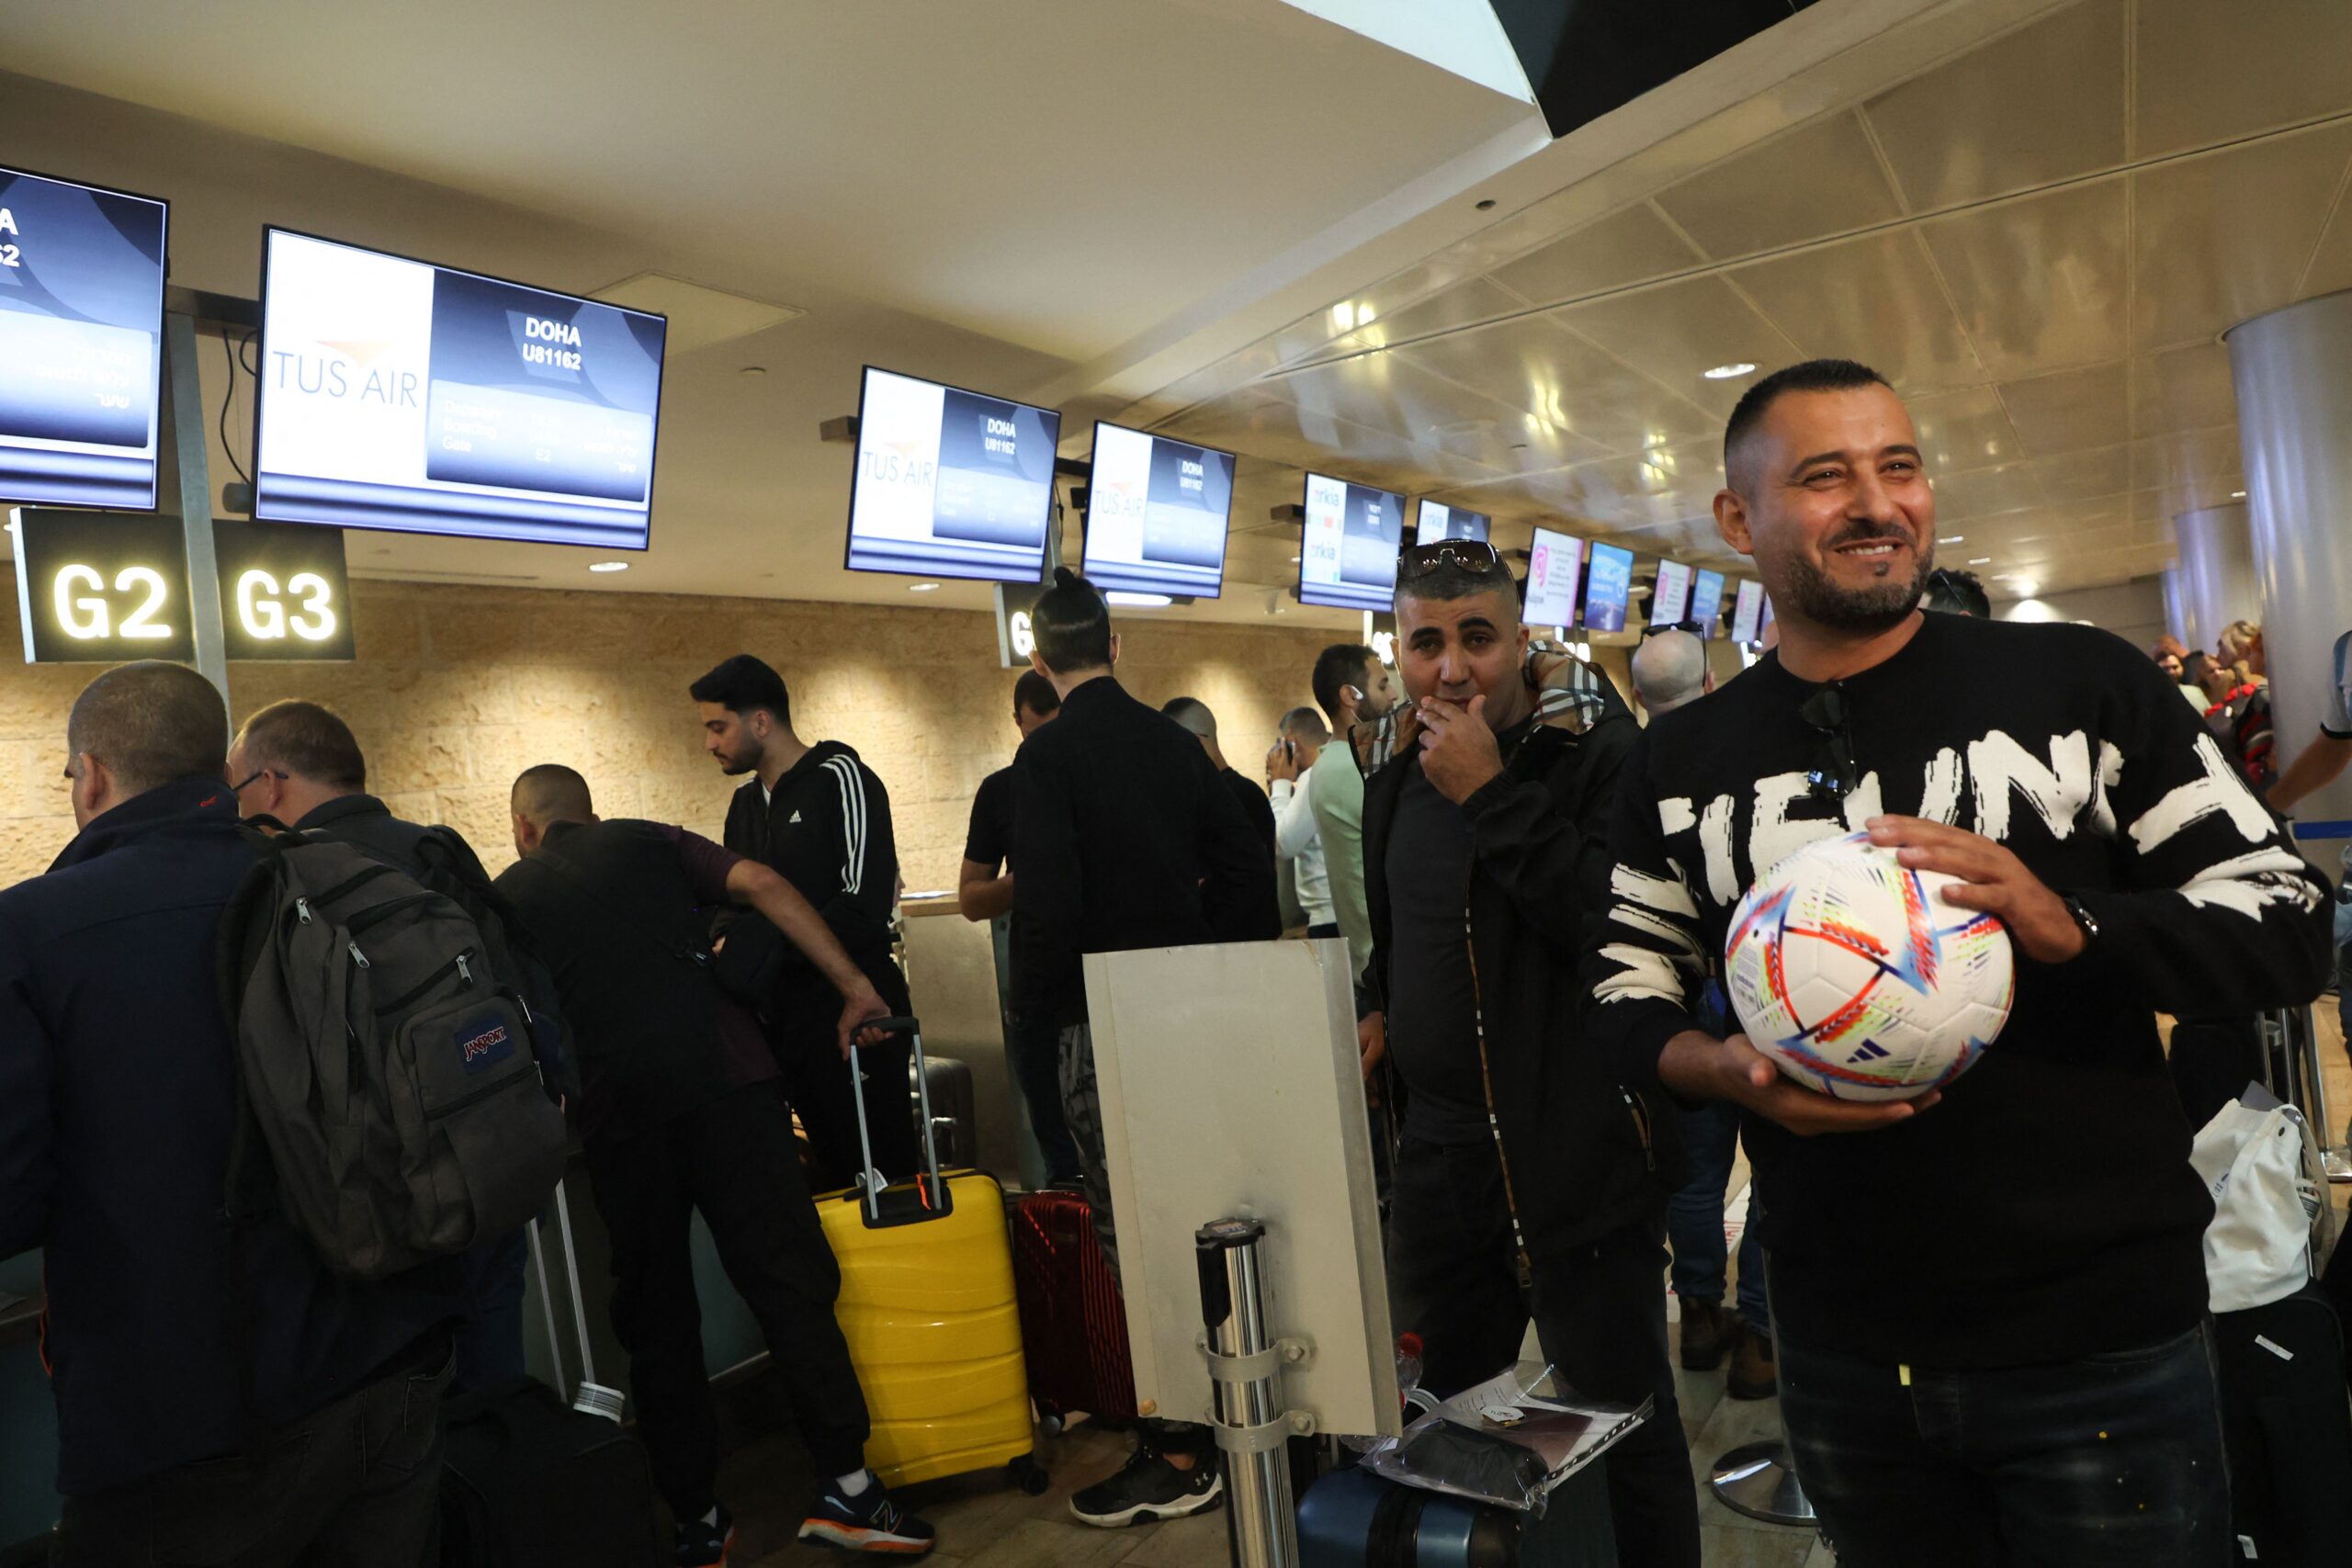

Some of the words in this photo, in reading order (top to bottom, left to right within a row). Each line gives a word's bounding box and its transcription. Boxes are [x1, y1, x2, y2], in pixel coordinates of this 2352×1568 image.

[526, 316, 582, 347] DOHA
[522, 343, 582, 371] U81162
[273, 350, 346, 398] TUS
[361, 368, 417, 408] AIR
[987, 418, 1016, 438] DOHA
[864, 451, 899, 482] TUS
[903, 460, 933, 487] AIR
[1094, 491, 1119, 515] TUS
[1122, 496, 1144, 517] AIR
[53, 563, 172, 639] G2
[236, 569, 336, 640] G3
[463, 1026, 507, 1062] JANSPORT
